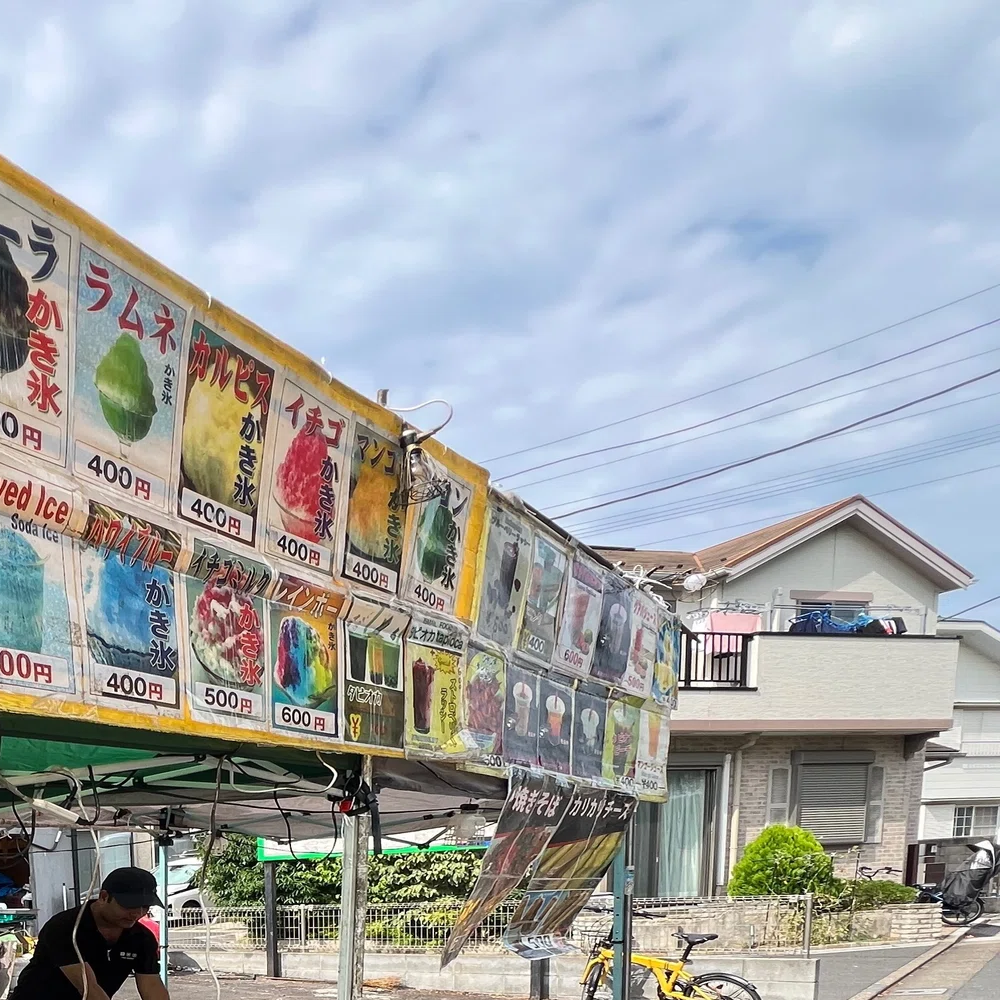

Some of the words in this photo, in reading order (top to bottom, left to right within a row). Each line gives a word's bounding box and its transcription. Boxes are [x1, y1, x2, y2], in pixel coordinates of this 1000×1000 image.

[85, 260, 178, 355] ラムネ
[25, 288, 63, 417] かき氷
[188, 329, 272, 415] カルピス
[162, 363, 176, 406] かき氷
[285, 393, 346, 448] イチゴ
[87, 454, 151, 501] 400円
[233, 411, 262, 508] かき氷
[34, 484, 70, 525] Ice
[190, 498, 241, 536] 400円
[314, 456, 340, 542] かき氷
[10, 512, 39, 538] Soda
[42, 523, 60, 544] Ice
[276, 535, 321, 567] 400円
[441, 522, 461, 591] かき氷
[352, 561, 389, 589] 400円
[272, 578, 338, 619] レインボー
[414, 583, 445, 612] 400円
[145, 578, 176, 672] かき氷
[238, 603, 263, 687] かき氷
[436, 629, 464, 650] tapioca
[106, 673, 164, 701] 400円
[204, 687, 253, 715] 500円
[281, 706, 326, 732] 600円
[512, 785, 563, 816] 焼きそば
